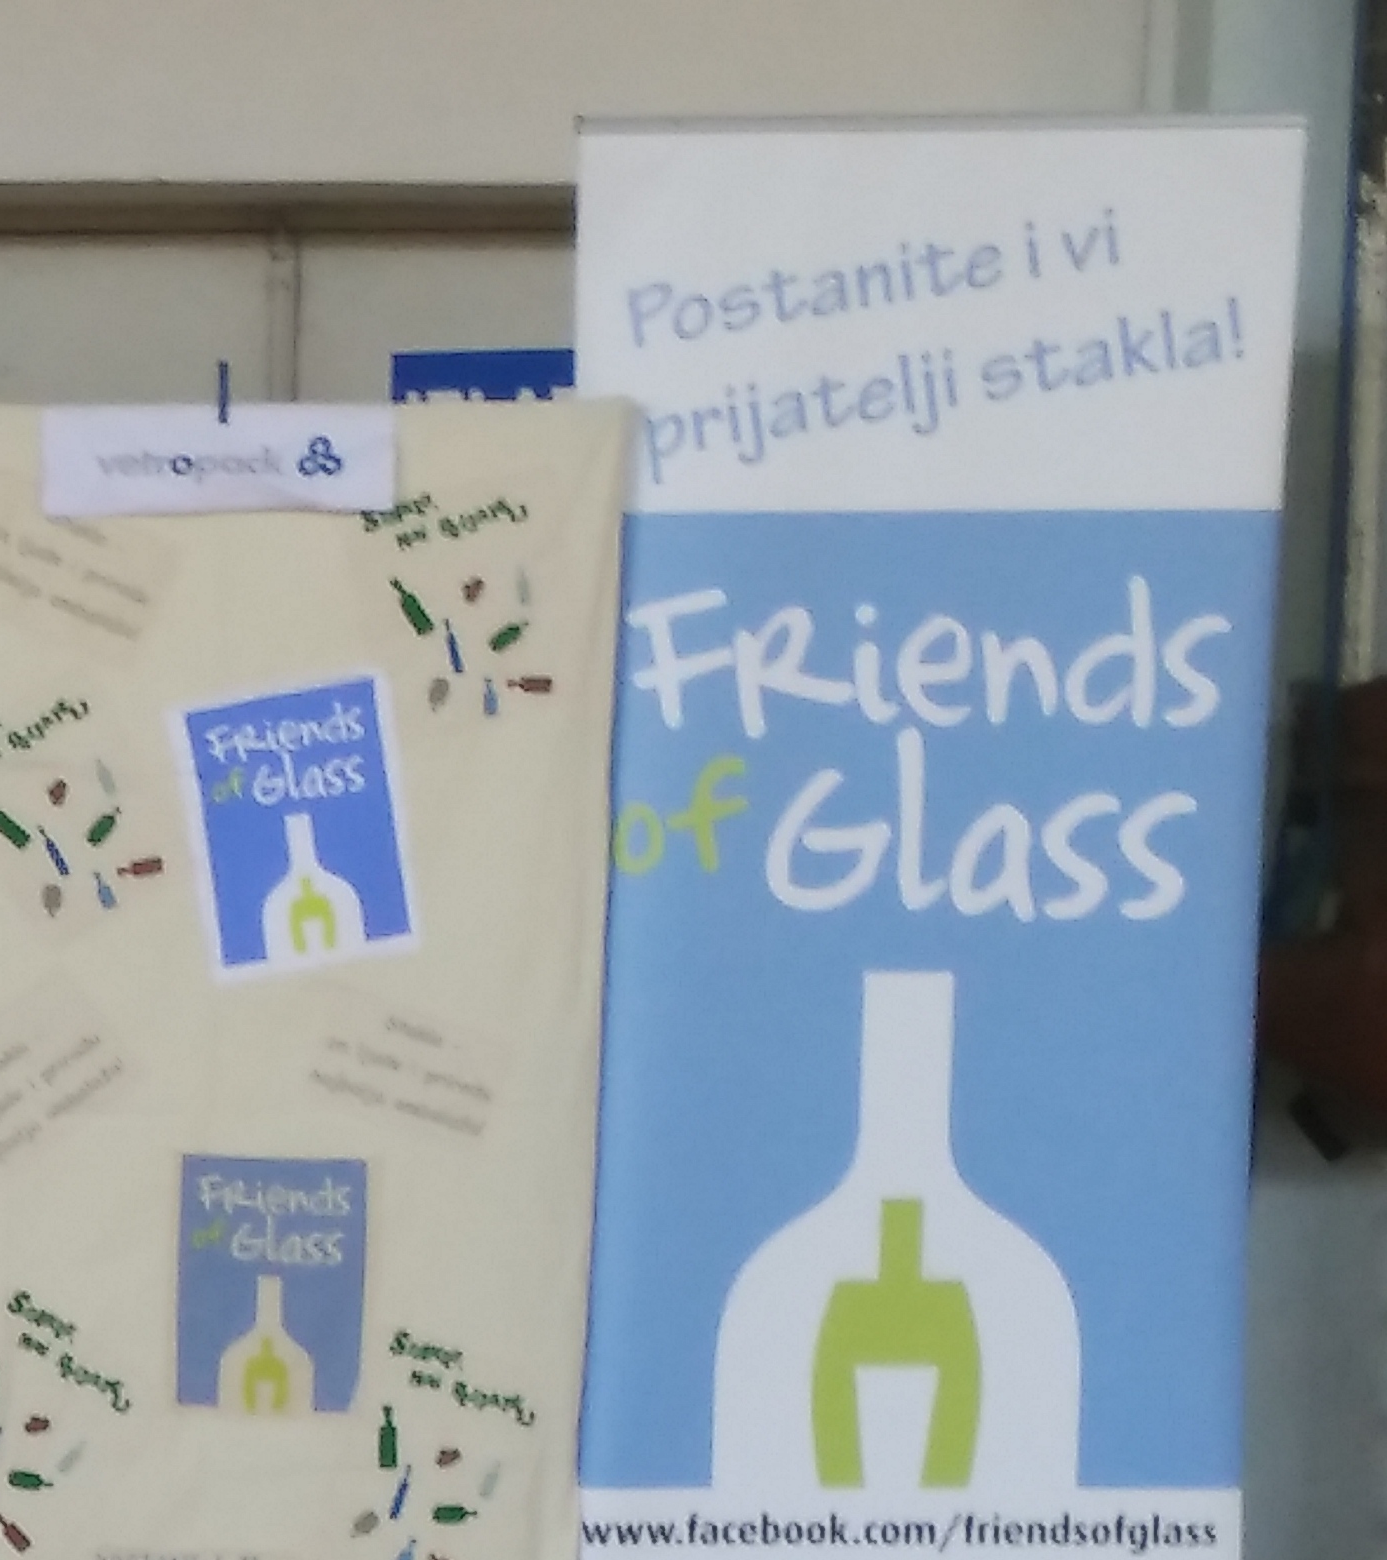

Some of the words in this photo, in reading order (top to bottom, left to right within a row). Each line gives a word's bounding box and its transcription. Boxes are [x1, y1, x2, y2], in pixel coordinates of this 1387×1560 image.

[629, 231, 1005, 348] Postanite
[1025, 220, 1043, 279] i
[1062, 206, 1122, 272] vi
[643, 348, 959, 485] prijatelji
[979, 295, 1249, 402] stakla!
[253, 750, 366, 807] Glass
[611, 754, 749, 877] of
[766, 726, 1199, 923] Glass
[581, 1512, 1219, 1553] www.facebook.com/friendsofglass
